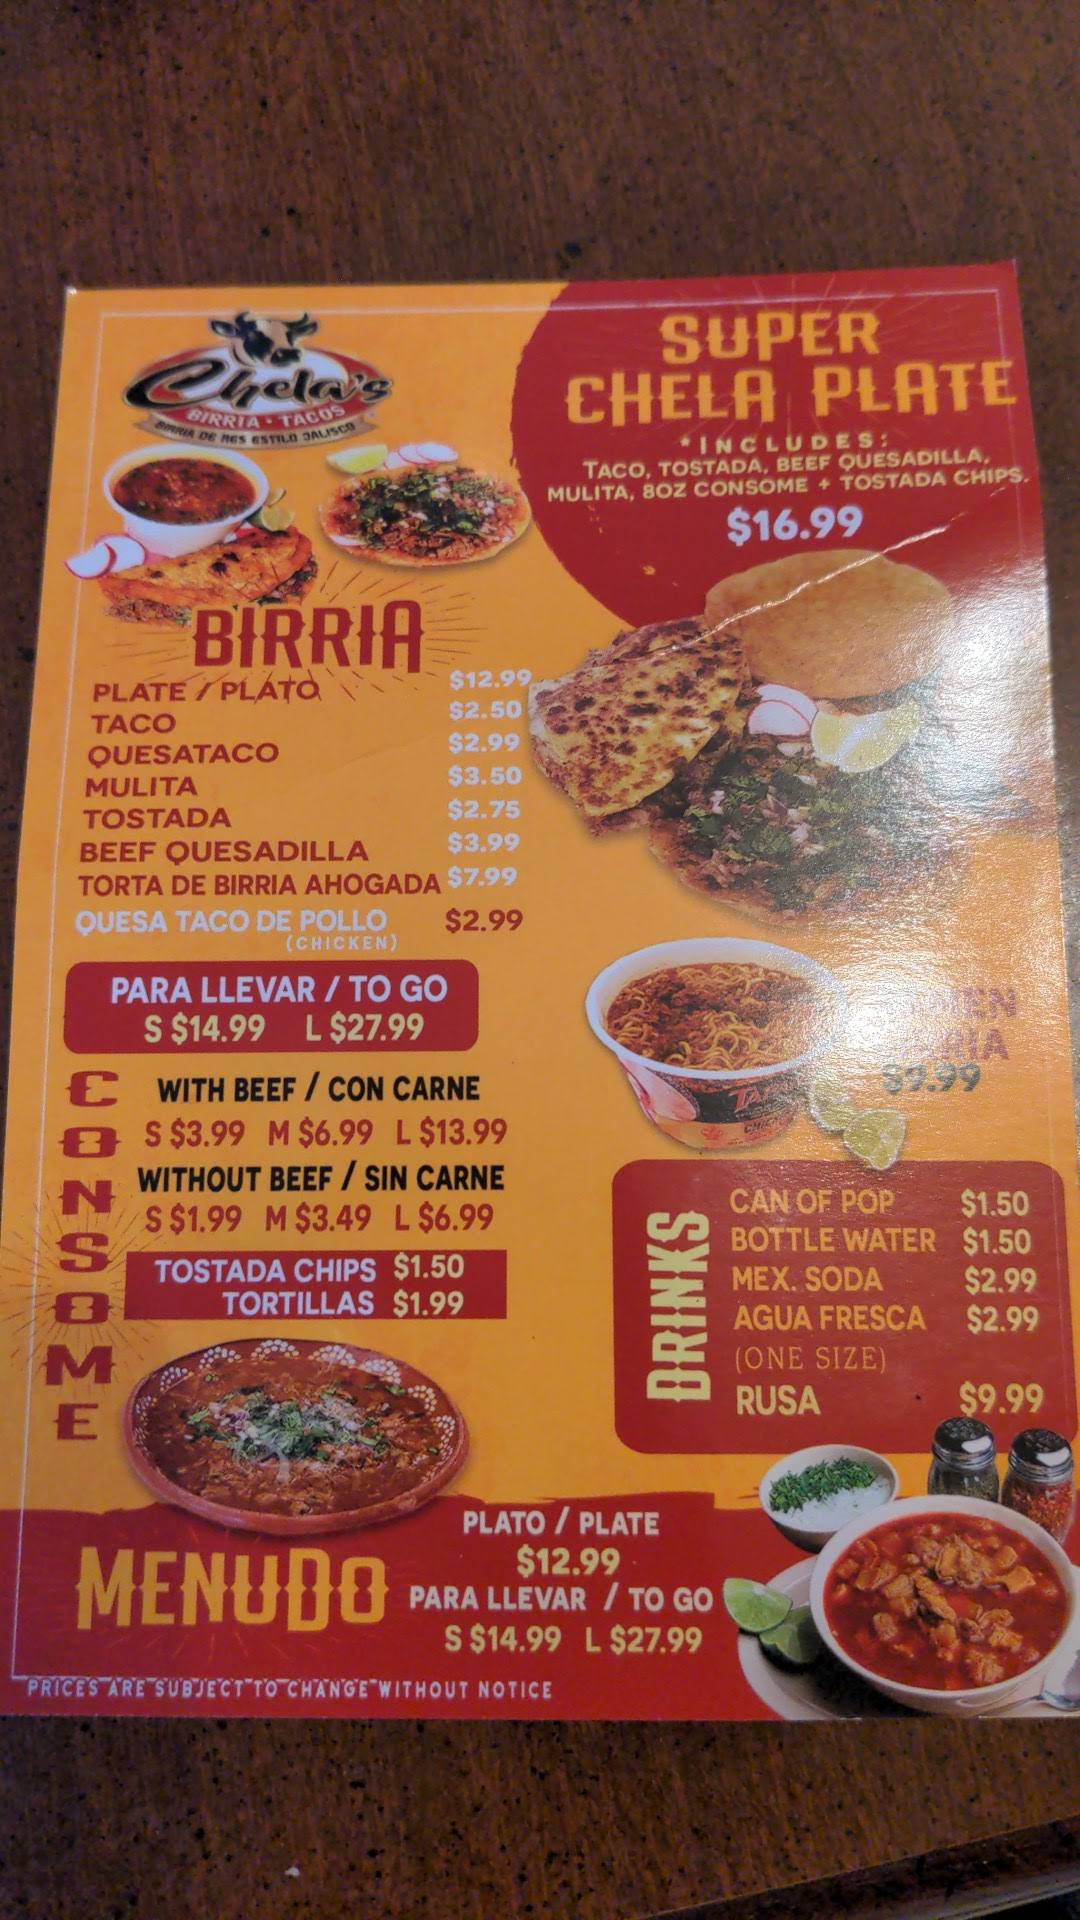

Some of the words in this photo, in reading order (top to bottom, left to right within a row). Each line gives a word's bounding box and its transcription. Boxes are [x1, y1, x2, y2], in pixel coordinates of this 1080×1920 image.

[659, 310, 880, 365] SUPER
[125, 357, 392, 409] Chela's
[564, 367, 776, 427] CHELA
[811, 360, 1018, 417] PLATE
[186, 406, 260, 429] BIRRIA
[278, 405, 345, 427] TACOS
[199, 430, 216, 444] DE
[221, 432, 246, 445] RES
[251, 433, 298, 445] ESTILO
[302, 422, 356, 442] JALISCO
[583, 459, 651, 480] TACO,
[659, 456, 768, 478] TOSTADA,
[776, 453, 831, 473] BEEF
[838, 448, 989, 473] QUESADILLA,
[547, 483, 635, 503] MULITA,
[693, 476, 808, 499] CONSOME
[818, 478, 829, 491] +
[840, 469, 946, 493] TOSTADA
[953, 466, 1029, 486] CHIPS.
[727, 505, 864, 547] $16.99
[192, 600, 424, 673] BIRRIA
[93, 681, 187, 702] PLATE
[195, 681, 212, 702] /
[221, 679, 320, 701] PLATO
[450, 669, 532, 691] $12.99
[91, 713, 176, 735] TACO
[448, 700, 522, 722] $2.50
[87, 742, 279, 768] QUESATACO
[448, 732, 520, 755] $2.99
[84, 775, 198, 798] MULITA
[448, 765, 522, 788] $3.50
[83, 807, 232, 830] TOSTADA
[447, 799, 521, 821] $2.75
[79, 841, 156, 863] BEEF
[166, 840, 369, 866] QUESADILLA
[447, 832, 520, 855] $3.99
[78, 874, 163, 897] TORTA
[172, 874, 205, 896] DE
[214, 874, 297, 896] BIRRIA
[305, 872, 441, 895] AHOGADA
[447, 866, 517, 889] $7.99
[75, 909, 168, 935] QUESA
[176, 909, 250, 933] TACO
[256, 909, 291, 932] DE
[300, 908, 387, 932] POLLO
[445, 907, 523, 933] $2.99
[286, 934, 398, 953] (CHICKEN)
[111, 977, 192, 1004] PARA
[202, 976, 316, 1003] LLEVAR
[324, 976, 340, 1002] /
[349, 975, 391, 1002] TO
[399, 974, 448, 1003] GO
[144, 1015, 162, 1044] S
[171, 1012, 266, 1046] $14.99
[306, 1015, 322, 1042] L
[330, 1011, 424, 1045] $27.99
[157, 1077, 225, 1103] WITH
[234, 1076, 296, 1102] BEEF
[304, 1071, 320, 1102] /
[328, 1076, 383, 1102] CON
[392, 1075, 480, 1101] CARNE
[145, 1120, 161, 1148] S
[170, 1118, 245, 1149] $3.99
[268, 1120, 289, 1146] M
[299, 1117, 373, 1148] $6.99
[397, 1119, 411, 1145] L
[420, 1116, 508, 1148] $13.99
[137, 1166, 261, 1193] WITHOUT
[269, 1166, 333, 1192] BEEF
[341, 1161, 358, 1191] /
[365, 1165, 410, 1191] SIN
[416, 1164, 505, 1191] CARNE
[145, 1205, 162, 1233] S
[170, 1203, 242, 1235] $1.99
[265, 1205, 287, 1231] M
[295, 1202, 372, 1235] $3.49
[394, 1204, 410, 1231] L
[418, 1201, 494, 1234] $6.99
[729, 1188, 789, 1214] CAN
[796, 1188, 831, 1213] OF
[841, 1188, 895, 1213] POP
[961, 1188, 1029, 1218] $1.50
[45, 1070, 121, 1441] CONSOME
[731, 1227, 837, 1252] BOTTLE
[844, 1226, 937, 1252] WATER
[962, 1226, 1031, 1256] $1.50
[154, 1258, 286, 1284] TOSTADA
[294, 1257, 377, 1284] CHIPS
[393, 1252, 465, 1280] $1.50
[732, 1266, 796, 1292] MEX.
[805, 1266, 883, 1292] SODA
[964, 1267, 1036, 1295] $2.99
[222, 1290, 374, 1317] TORTILLAS
[393, 1288, 465, 1318] $1.99
[646, 1209, 711, 1402] DRINKS
[734, 1305, 812, 1331] AGUA
[820, 1305, 926, 1330] FRESCA
[967, 1304, 1039, 1334] $2.99
[735, 1346, 803, 1374] (ONE
[816, 1346, 887, 1373] SIZE)
[736, 1385, 821, 1415] RUSA
[959, 1381, 1044, 1417] $9.99
[463, 1510, 545, 1535] PLATO
[554, 1506, 570, 1534] /
[579, 1511, 659, 1536] PLATE
[517, 1544, 620, 1578] $12.99
[410, 1585, 479, 1610] PARA
[488, 1586, 586, 1611] LLEVAR
[603, 1582, 619, 1611] /
[628, 1587, 664, 1612] TO
[673, 1587, 714, 1612] GO
[445, 1625, 462, 1652] S
[470, 1623, 562, 1654] $14.99
[586, 1626, 601, 1653] L
[610, 1624, 703, 1655] $27.99
[27, 1679, 98, 1697] PRICES
[107, 1679, 145, 1697] ARE
[154, 1679, 243, 1698] SUBJECT
[253, 1680, 277, 1698] TO
[288, 1680, 369, 1698] CHANGE
[379, 1680, 468, 1699] WITHOUT
[479, 1681, 552, 1699] NOTICE
